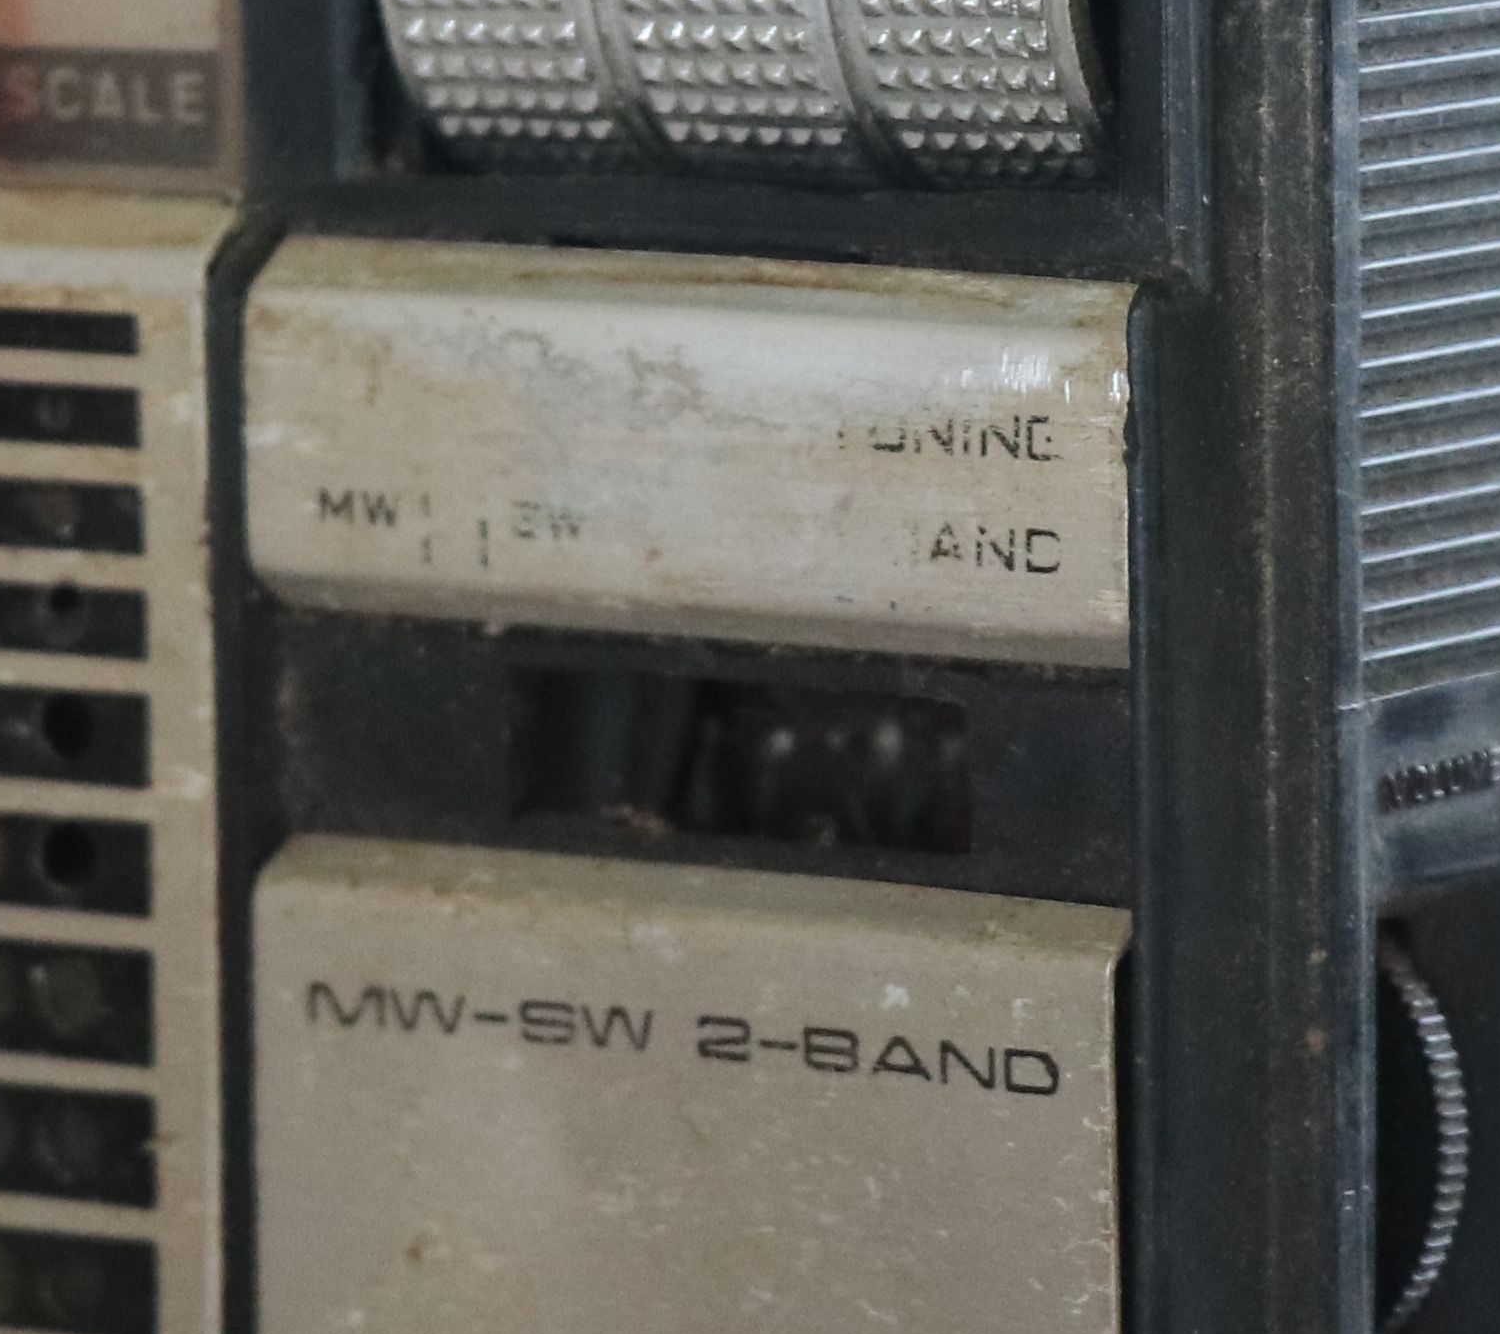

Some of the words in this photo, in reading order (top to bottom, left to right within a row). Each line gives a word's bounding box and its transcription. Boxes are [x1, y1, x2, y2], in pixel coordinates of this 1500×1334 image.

[2, 65, 211, 126] SCALE
[316, 486, 399, 529] MW
[305, 980, 656, 1053] MW-SW
[696, 1013, 1062, 1098] 2-BAND
